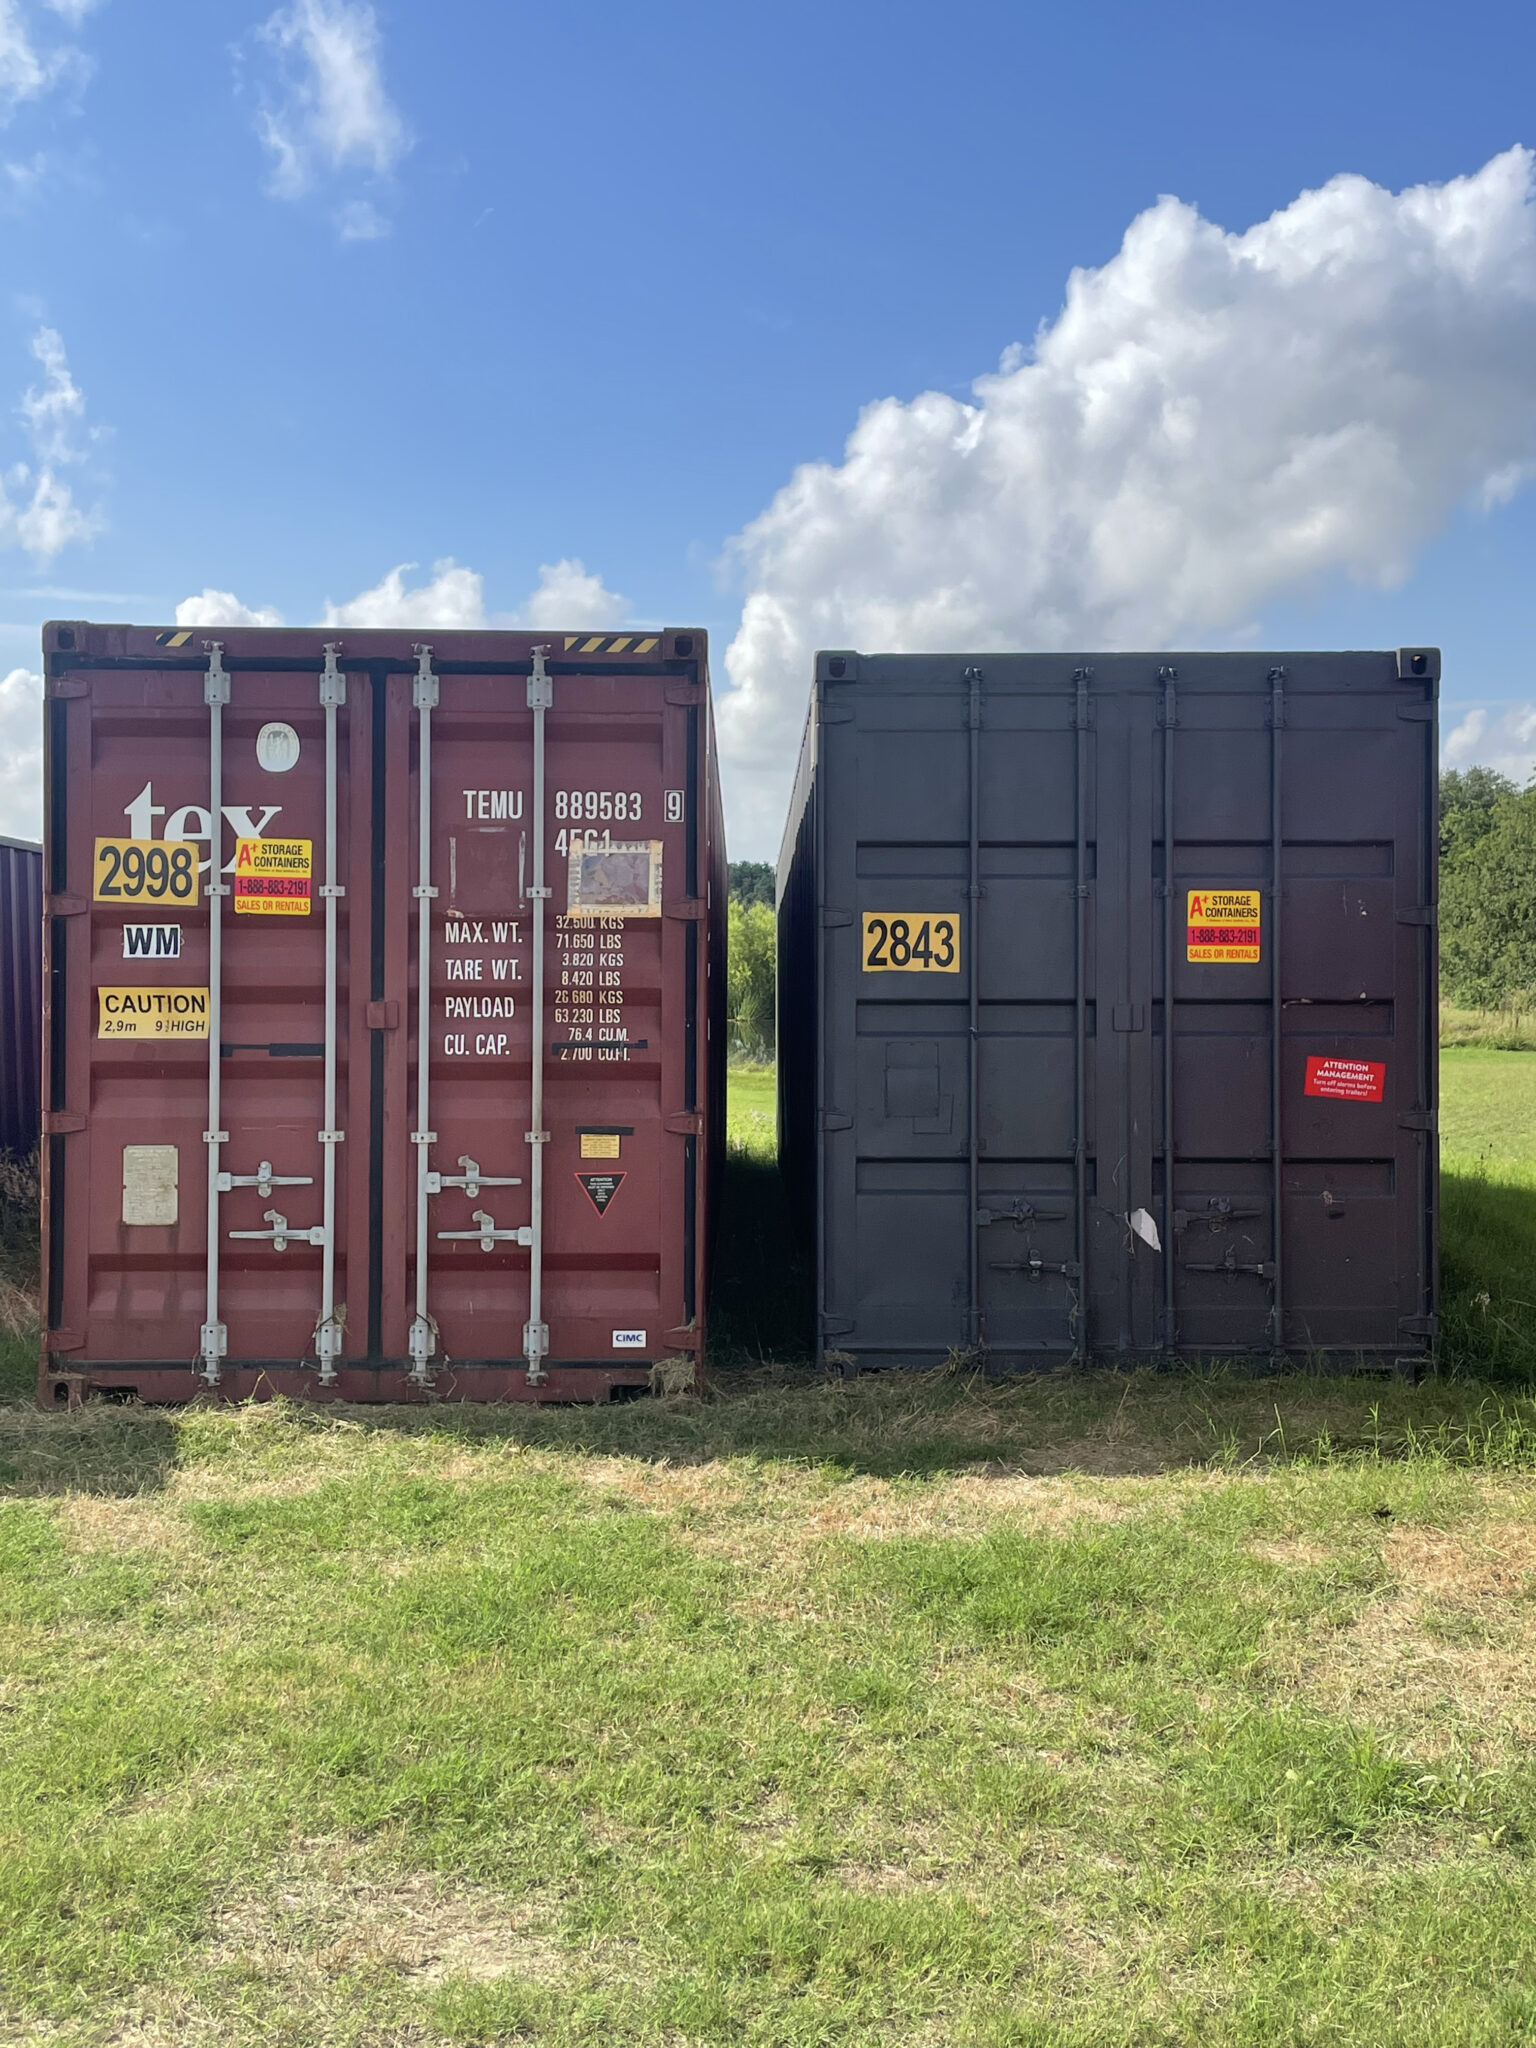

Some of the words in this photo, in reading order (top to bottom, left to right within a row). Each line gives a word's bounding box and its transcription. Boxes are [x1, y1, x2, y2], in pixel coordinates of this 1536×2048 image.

[463, 790, 523, 819] TEMU
[554, 790, 642, 821] 889583
[666, 792, 682, 820] 9
[261, 844, 303, 856] STORAGE
[254, 856, 310, 869] CONTAINERS
[98, 845, 193, 898] 2998
[238, 879, 309, 895] 1-888-883-2191
[236, 900, 260, 911] SALES
[262, 901, 273, 911] OR
[275, 901, 309, 912] RENTALS
[1212, 895, 1252, 906] STORAGE
[1205, 907, 1258, 918] CONTAINERS
[555, 915, 595, 929] 32.500
[600, 915, 625, 930] KGS
[445, 922, 489, 943] MAX.
[492, 922, 523, 943] WT.
[1191, 929, 1257, 943] 1-888-883-2191
[126, 927, 179, 955] WM
[555, 934, 594, 949] 71.650
[600, 934, 622, 949] LBS
[867, 919, 954, 968] 2843
[562, 953, 594, 967] 3.820
[600, 953, 625, 967] KGS
[1189, 948, 1212, 959] SALES
[1213, 949, 1224, 959] OR
[1226, 949, 1258, 959] RENTALS
[445, 959, 483, 980] TARE
[492, 959, 523, 980] WT.
[561, 971, 593, 986] 8.420
[599, 971, 621, 986] LBS
[105, 995, 206, 1013] CAUTION
[599, 990, 624, 1004] KGS
[445, 997, 515, 1018] PAYLOAD
[555, 1008, 593, 1023] 63.230
[599, 1008, 621, 1023] LBS
[568, 1027, 593, 1041] 76.4
[444, 1034, 470, 1055] CU.
[475, 1034, 510, 1055] CAP.
[1323, 1061, 1369, 1072] ATTENTION
[1316, 1069, 1375, 1082] MANAGEMENT
[1320, 1087, 1345, 1095] entering
[1337, 1081, 1356, 1089] alarms
[1357, 1083, 1377, 1091] before
[616, 1334, 643, 1342] CIMC
